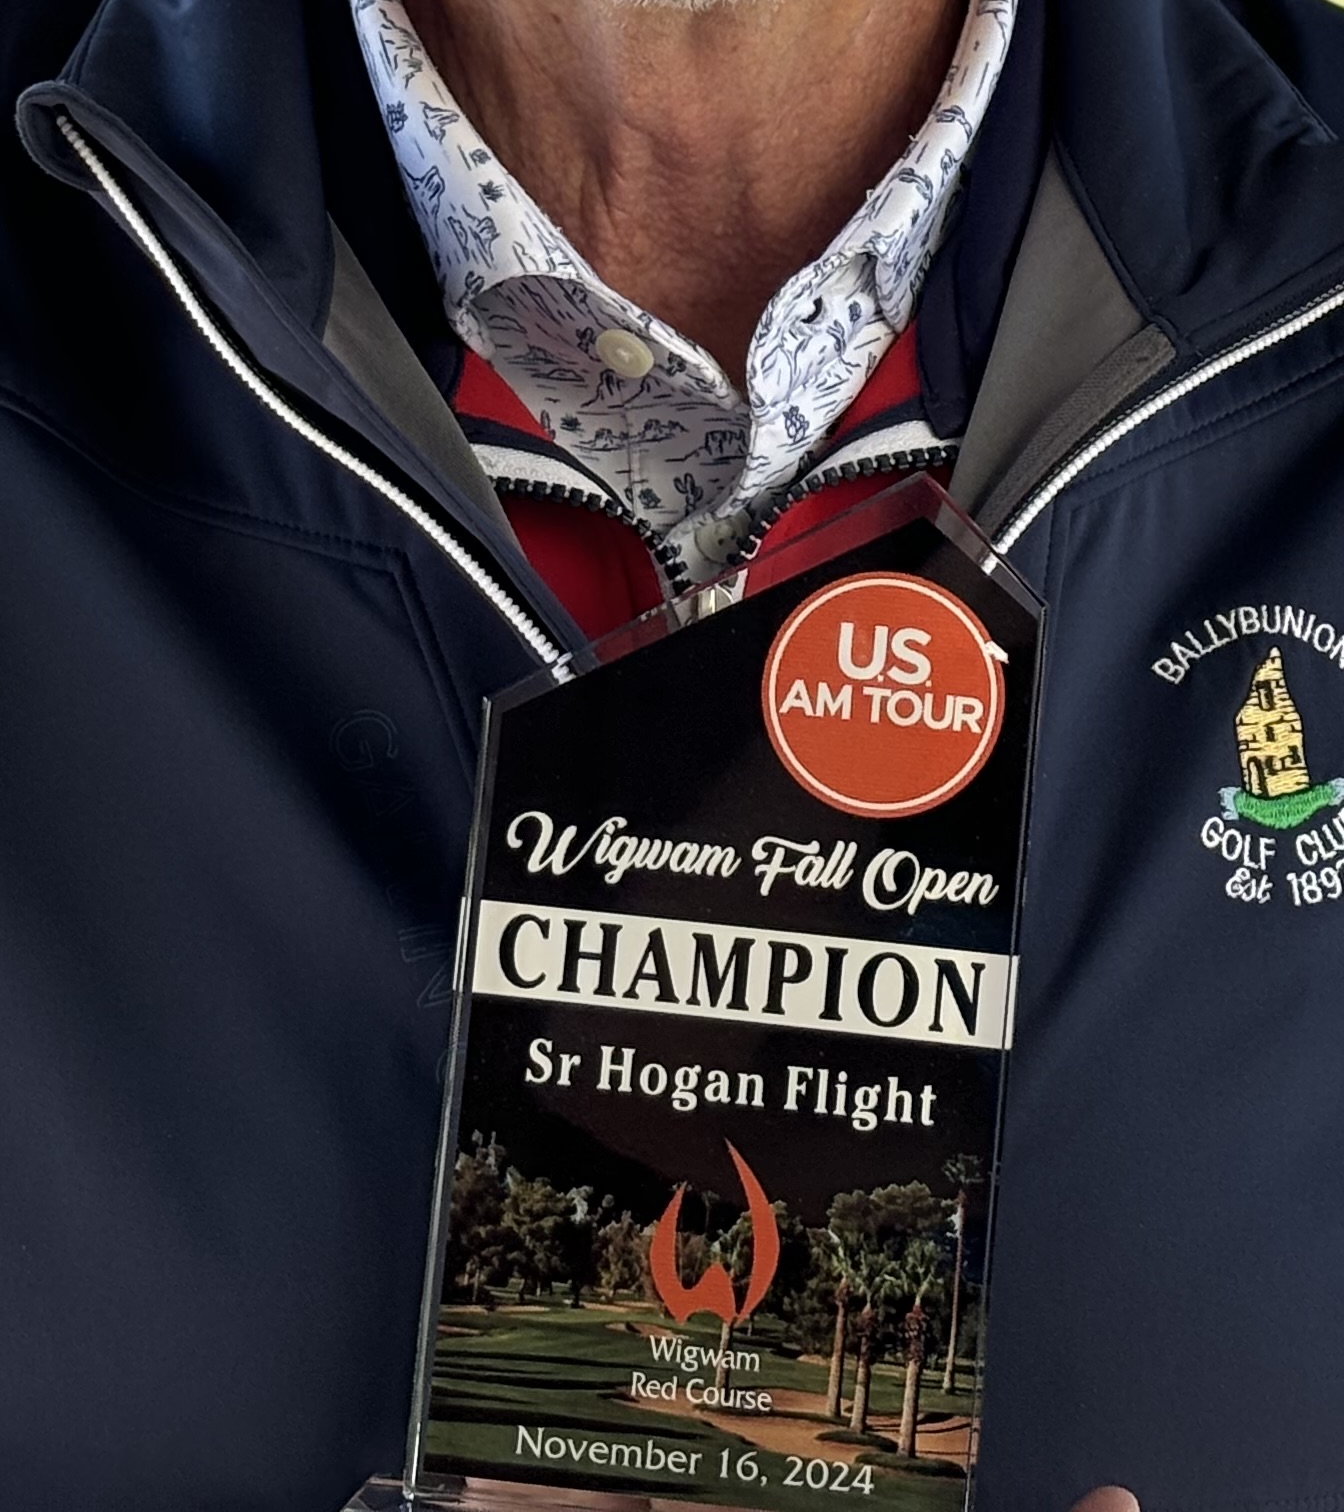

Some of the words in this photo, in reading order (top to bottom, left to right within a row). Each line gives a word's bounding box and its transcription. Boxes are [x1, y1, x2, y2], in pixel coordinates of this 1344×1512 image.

[779, 679, 852, 721] AM
[862, 684, 986, 734] TOUR
[506, 810, 742, 884] Wigwam
[754, 835, 856, 896] Fall
[862, 848, 1000, 916] Open
[1200, 816, 1276, 871] GOLF
[498, 912, 986, 1037] CHAMPION
[524, 1038, 581, 1086] Sr
[598, 1044, 765, 1112] Hogan
[783, 1064, 938, 1132] Flight
[649, 1334, 761, 1375] Wigwam
[631, 1370, 678, 1401] Red
[685, 1378, 773, 1412] Course
[514, 1424, 703, 1476] November
[718, 1448, 769, 1487] 16,
[784, 1455, 876, 1494] 2024
